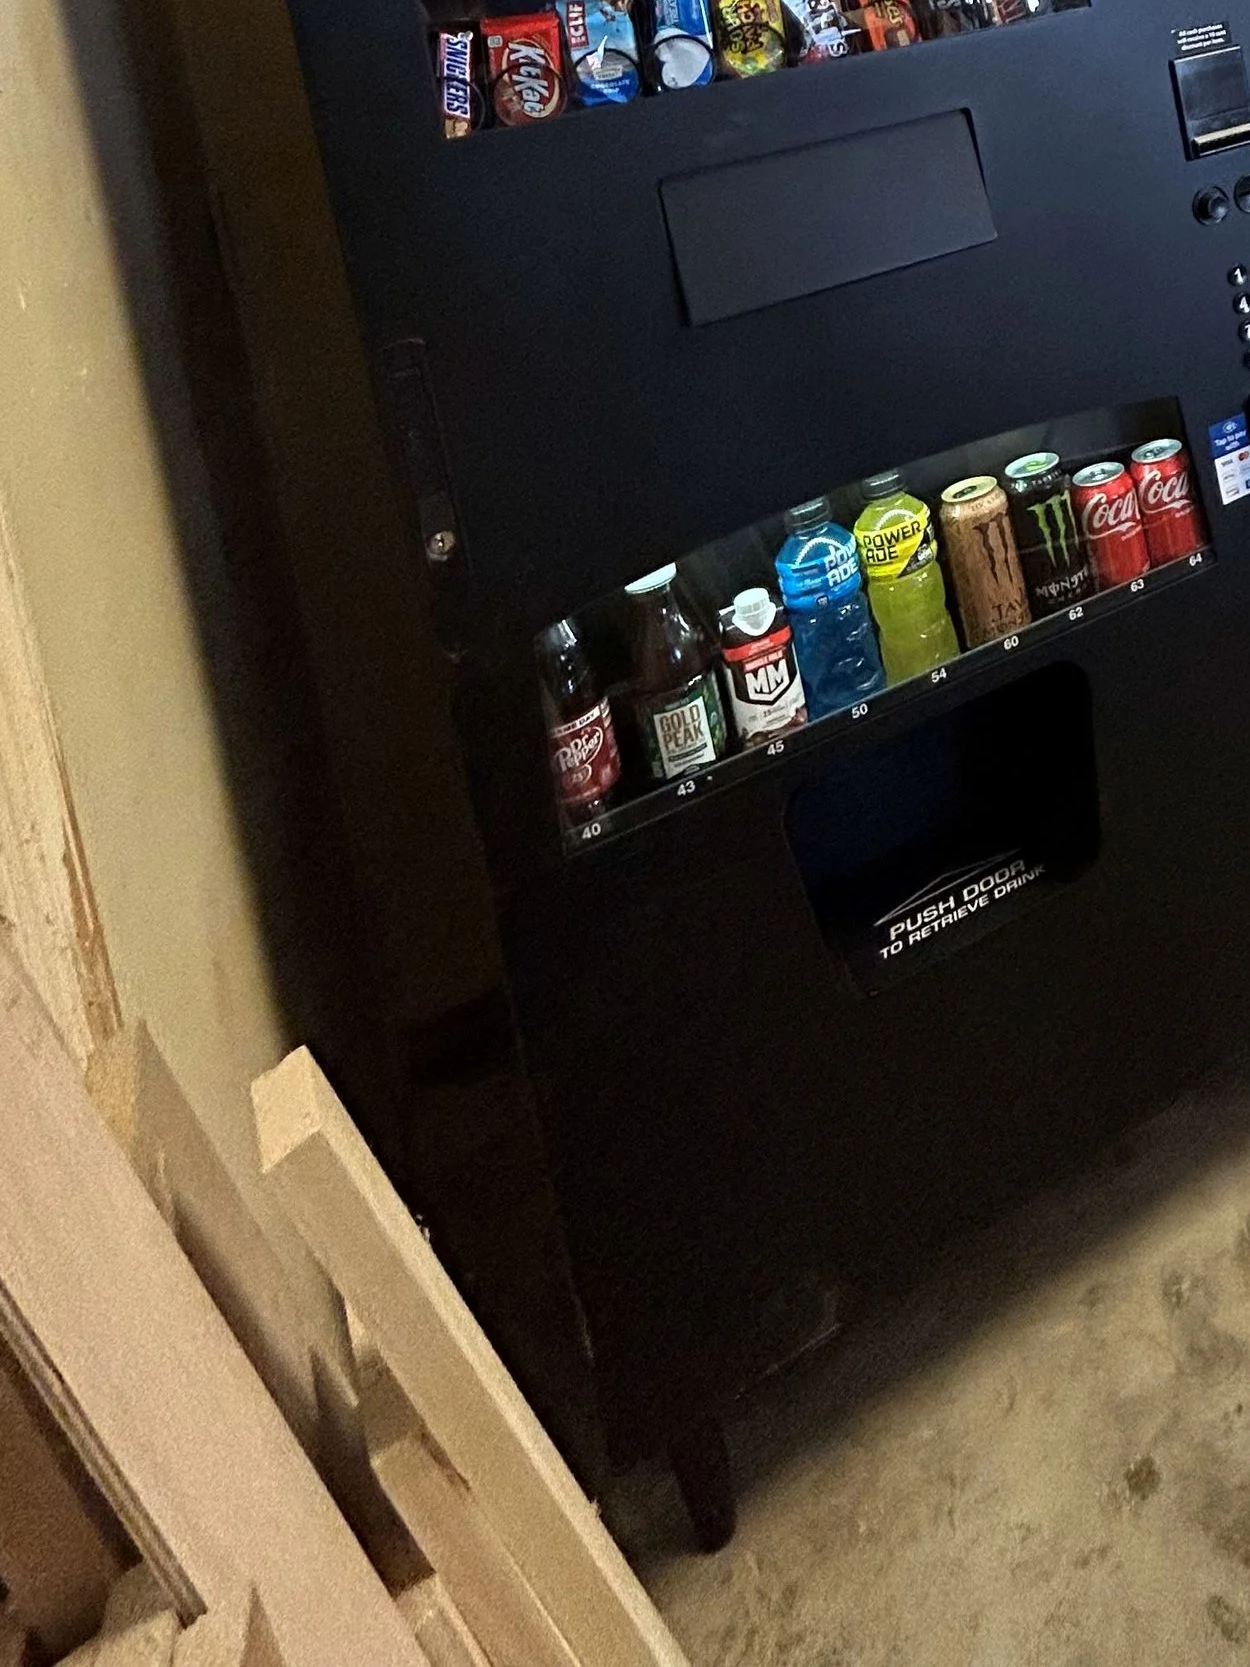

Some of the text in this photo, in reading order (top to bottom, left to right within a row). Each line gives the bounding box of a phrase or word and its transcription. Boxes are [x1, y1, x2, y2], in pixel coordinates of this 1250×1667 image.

[721, 2, 746, 54] SOUR
[1234, 268, 1244, 284] 1
[1239, 296, 1250, 313] 4
[1214, 437, 1227, 447] Tap
[1235, 430, 1247, 440] pay
[863, 520, 921, 548] POWER
[865, 545, 899, 564] ADE
[1189, 552, 1203, 567] 64
[826, 561, 861, 587] ADE
[1130, 578, 1145, 592] 63
[1068, 606, 1084, 621] 62
[1003, 635, 1020, 651] 60
[930, 672, 948, 684] 54
[660, 703, 701, 734] GOLD
[851, 703, 869, 720] 50
[570, 734, 590, 749] Dr
[662, 720, 705, 751] PEAK
[556, 731, 600, 773] Pepper
[767, 740, 785, 756] 45
[677, 780, 696, 797] 43
[581, 822, 601, 840] 40
[889, 859, 1026, 941] PUSH DOOR
[879, 864, 1046, 960] TO RETRIEVE DRINK
